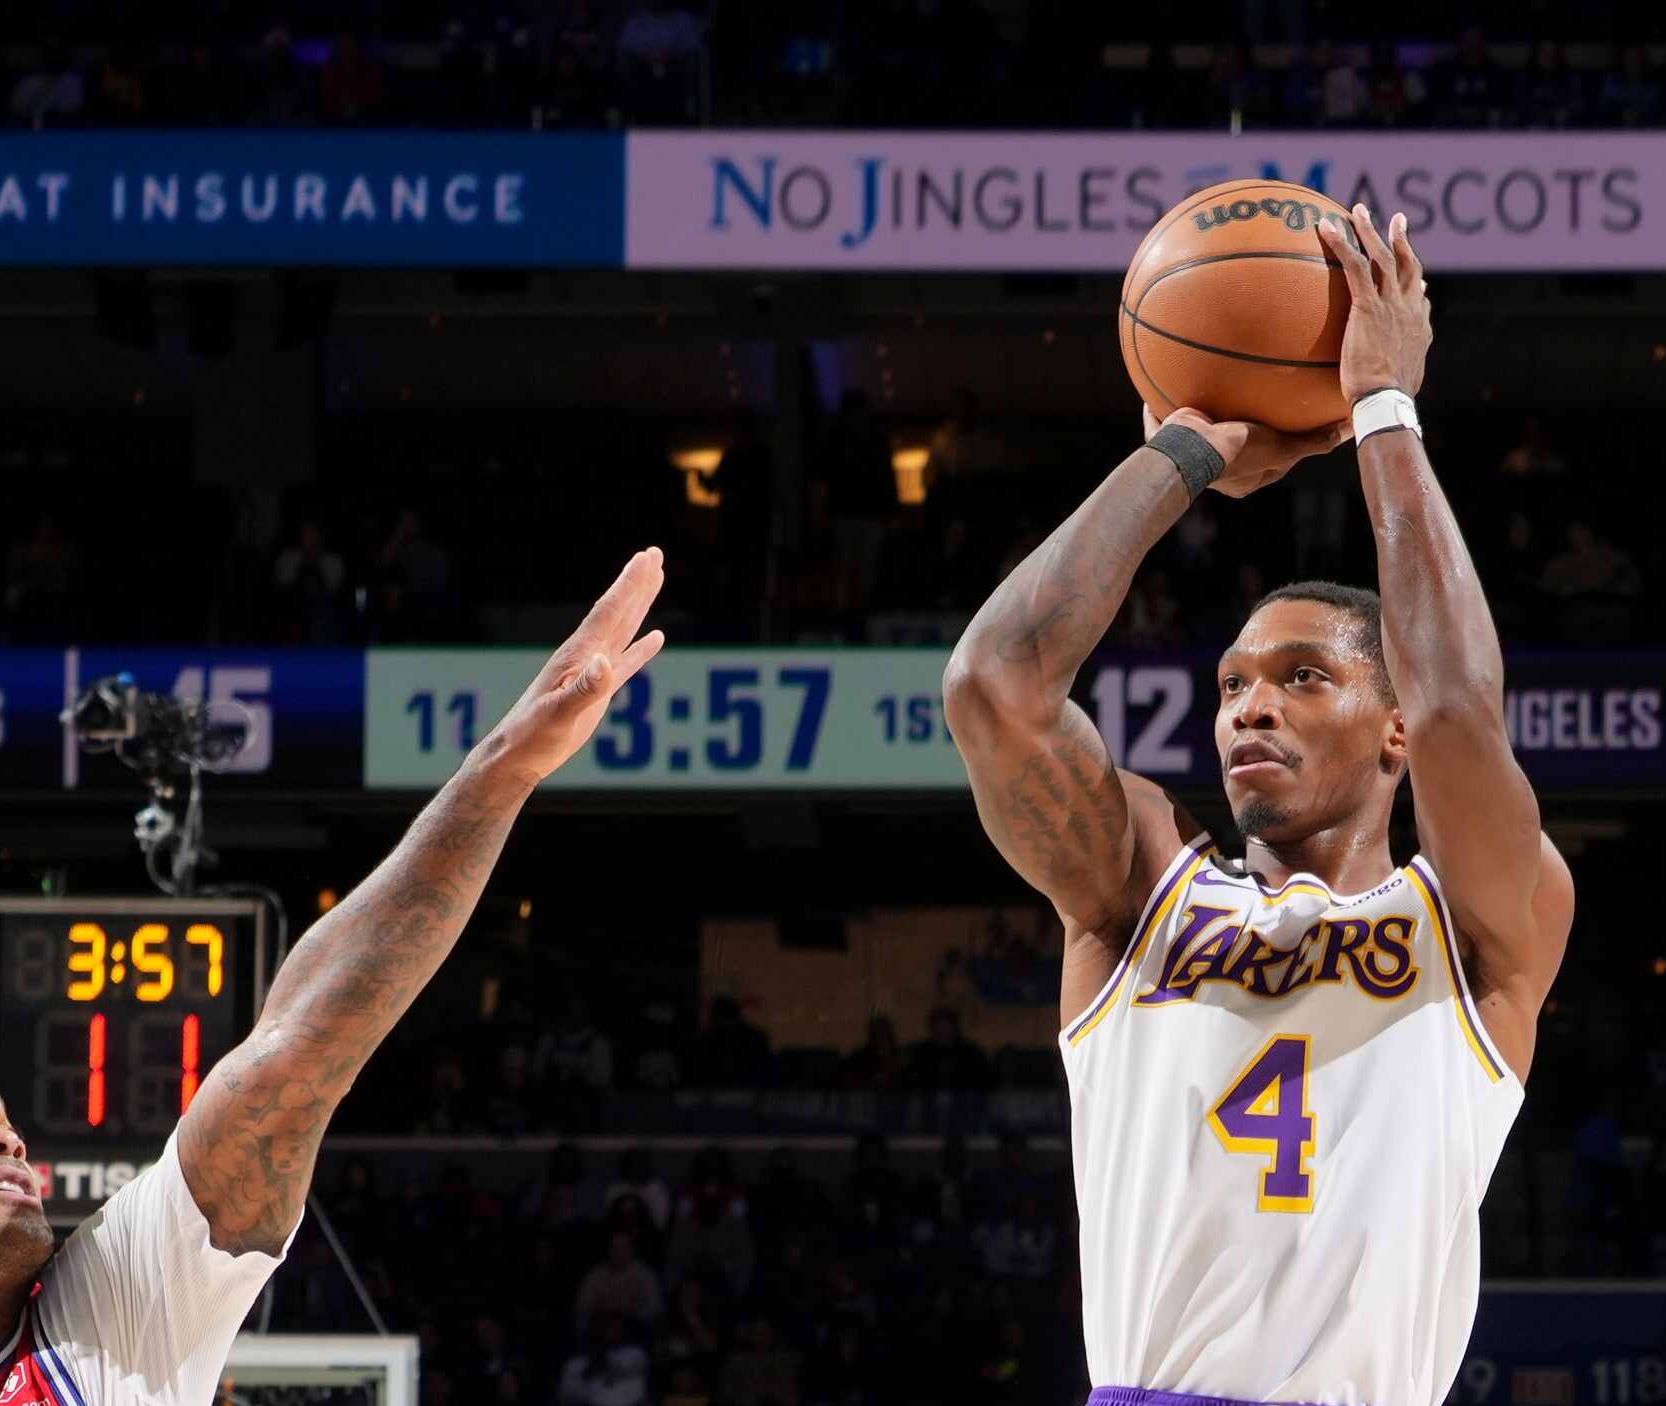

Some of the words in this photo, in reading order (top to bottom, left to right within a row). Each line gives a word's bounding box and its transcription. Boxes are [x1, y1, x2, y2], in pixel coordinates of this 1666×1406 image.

[112, 173, 526, 223] INSURANCE
[710, 155, 830, 232] NO
[840, 157, 1164, 248] JINGLES
[406, 692, 477, 751] 11
[592, 666, 831, 770] 3:57
[1091, 666, 1192, 773] 12
[1508, 687, 1662, 749] GELES
[66, 922, 224, 1002] 3:57
[1131, 904, 1421, 1008] LAKERS
[87, 1012, 199, 1127] 11
[1207, 1033, 1317, 1212] 4
[55, 1162, 159, 1200] TIS
